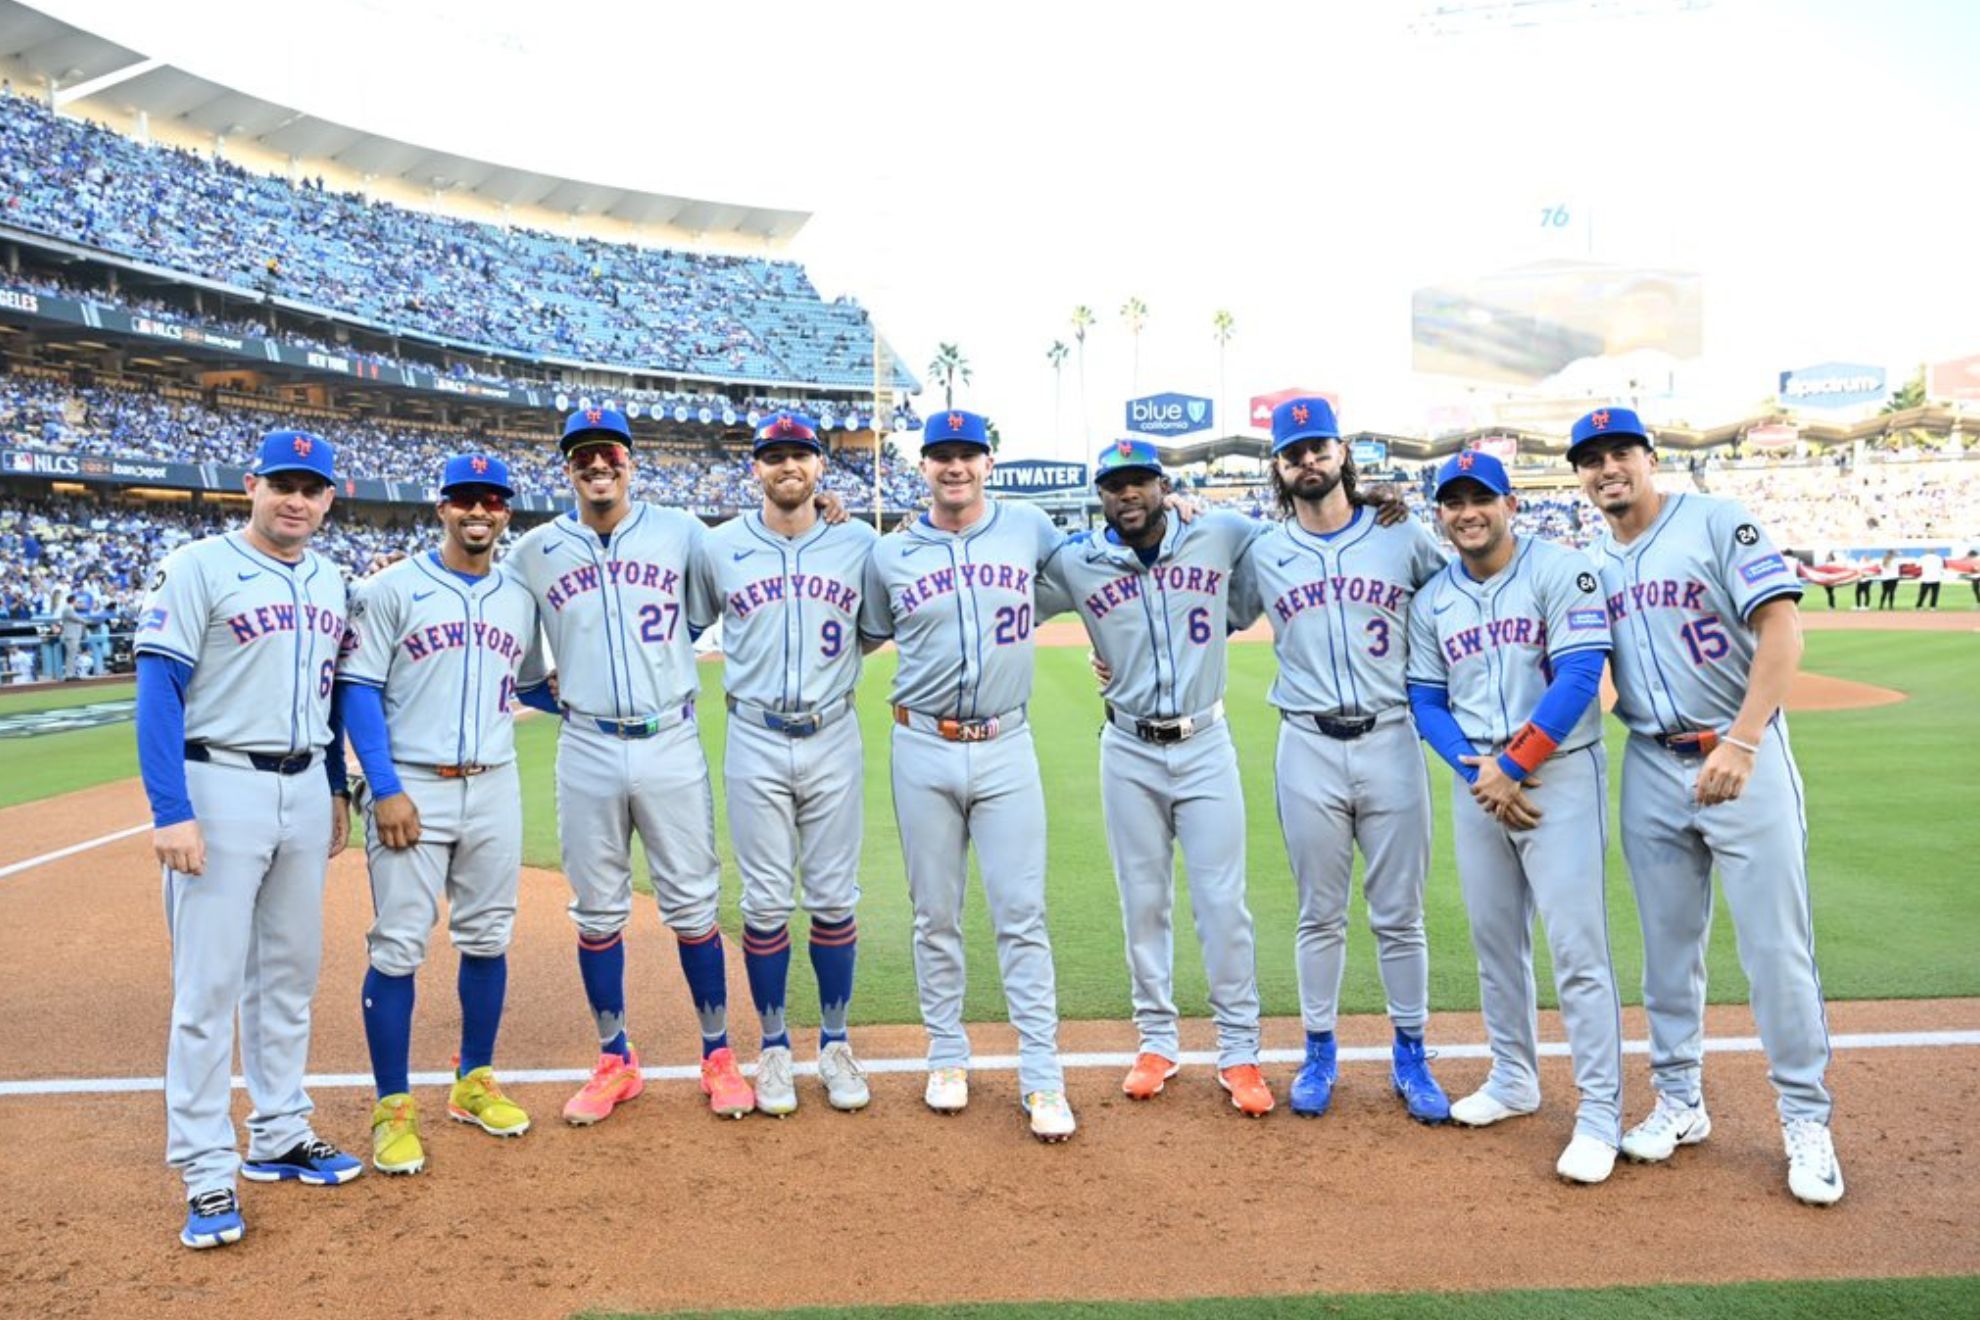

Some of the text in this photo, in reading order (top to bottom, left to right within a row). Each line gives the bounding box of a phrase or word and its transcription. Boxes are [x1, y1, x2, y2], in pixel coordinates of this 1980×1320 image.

[1540, 202, 1570, 228] 76
[1132, 401, 1182, 420] blue
[1140, 420, 1188, 431] california
[34, 454, 78, 474] NLCS
[1737, 527, 1758, 543] 24
[546, 561, 680, 612] NEW YORK
[730, 574, 858, 619] NEW YORK
[901, 564, 1030, 614] NEW YORK
[1086, 566, 1222, 619] NEW YORK
[1274, 577, 1405, 624] NEW YORK
[1580, 576, 1595, 590] 24
[1630, 580, 1708, 612] YORK
[227, 604, 344, 646] NEW YOR
[403, 621, 465, 662] NEW
[638, 602, 681, 644] 27
[820, 619, 843, 658] 9
[994, 602, 1031, 646] 20
[1188, 605, 1212, 646] 6
[1365, 618, 1391, 659] 3
[1680, 614, 1731, 666] 15
[1444, 626, 1484, 663] EW
[499, 673, 518, 714] 1
